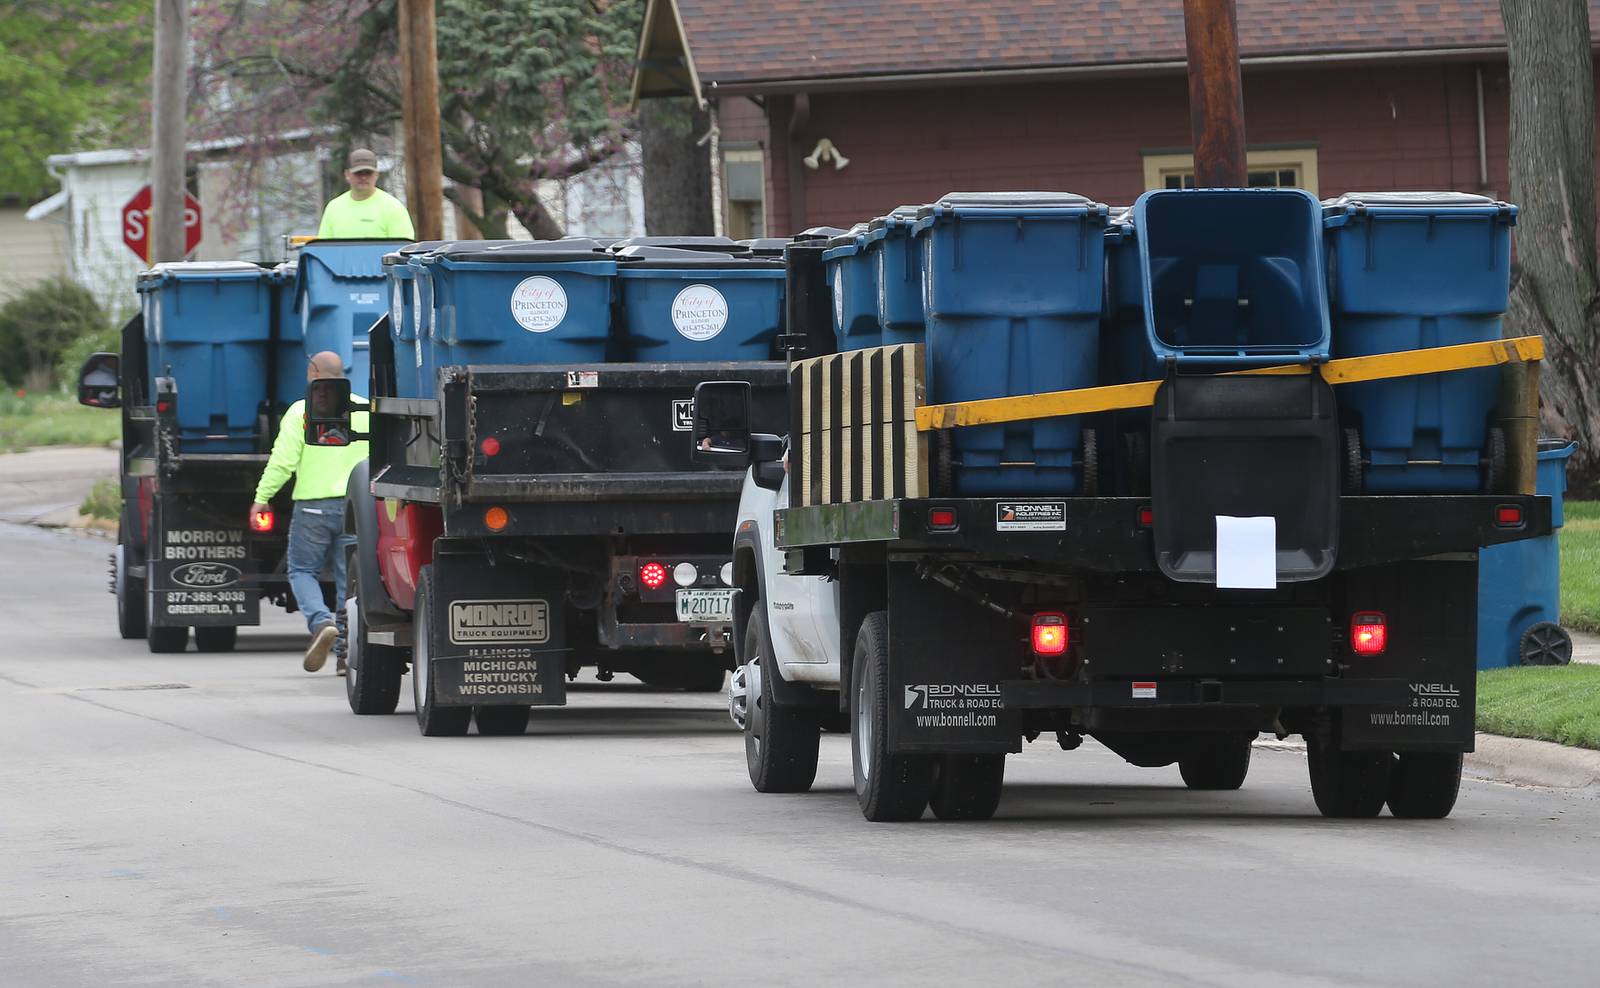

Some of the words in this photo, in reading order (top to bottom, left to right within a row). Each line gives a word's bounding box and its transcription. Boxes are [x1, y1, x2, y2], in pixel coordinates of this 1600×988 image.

[126, 208, 199, 241] SP
[515, 300, 564, 310] PRINCETON
[675, 309, 725, 319] PRINCETON
[167, 530, 243, 543] MORROW
[165, 546, 246, 559] BROTHERS
[184, 564, 228, 584] Ford
[167, 604, 233, 614] GREENFIELD,
[236, 604, 246, 613] IL
[453, 604, 546, 626] MONROE
[469, 648, 532, 658] ILLINOIS
[464, 661, 537, 671] MICHIGAN
[464, 673, 538, 682] KENTUCKY
[459, 684, 543, 694] WISCONSIN
[929, 684, 1001, 695] BONNELL
[1409, 683, 1460, 695] NNELL
[929, 699, 957, 708] TRUCK
[959, 699, 965, 708] &
[967, 699, 990, 708] ROAD
[1413, 698, 1418, 707] &
[1421, 698, 1444, 707] ROAD
[916, 712, 996, 727] www.bonnell.com
[1371, 711, 1450, 725] www.bonnell.com
